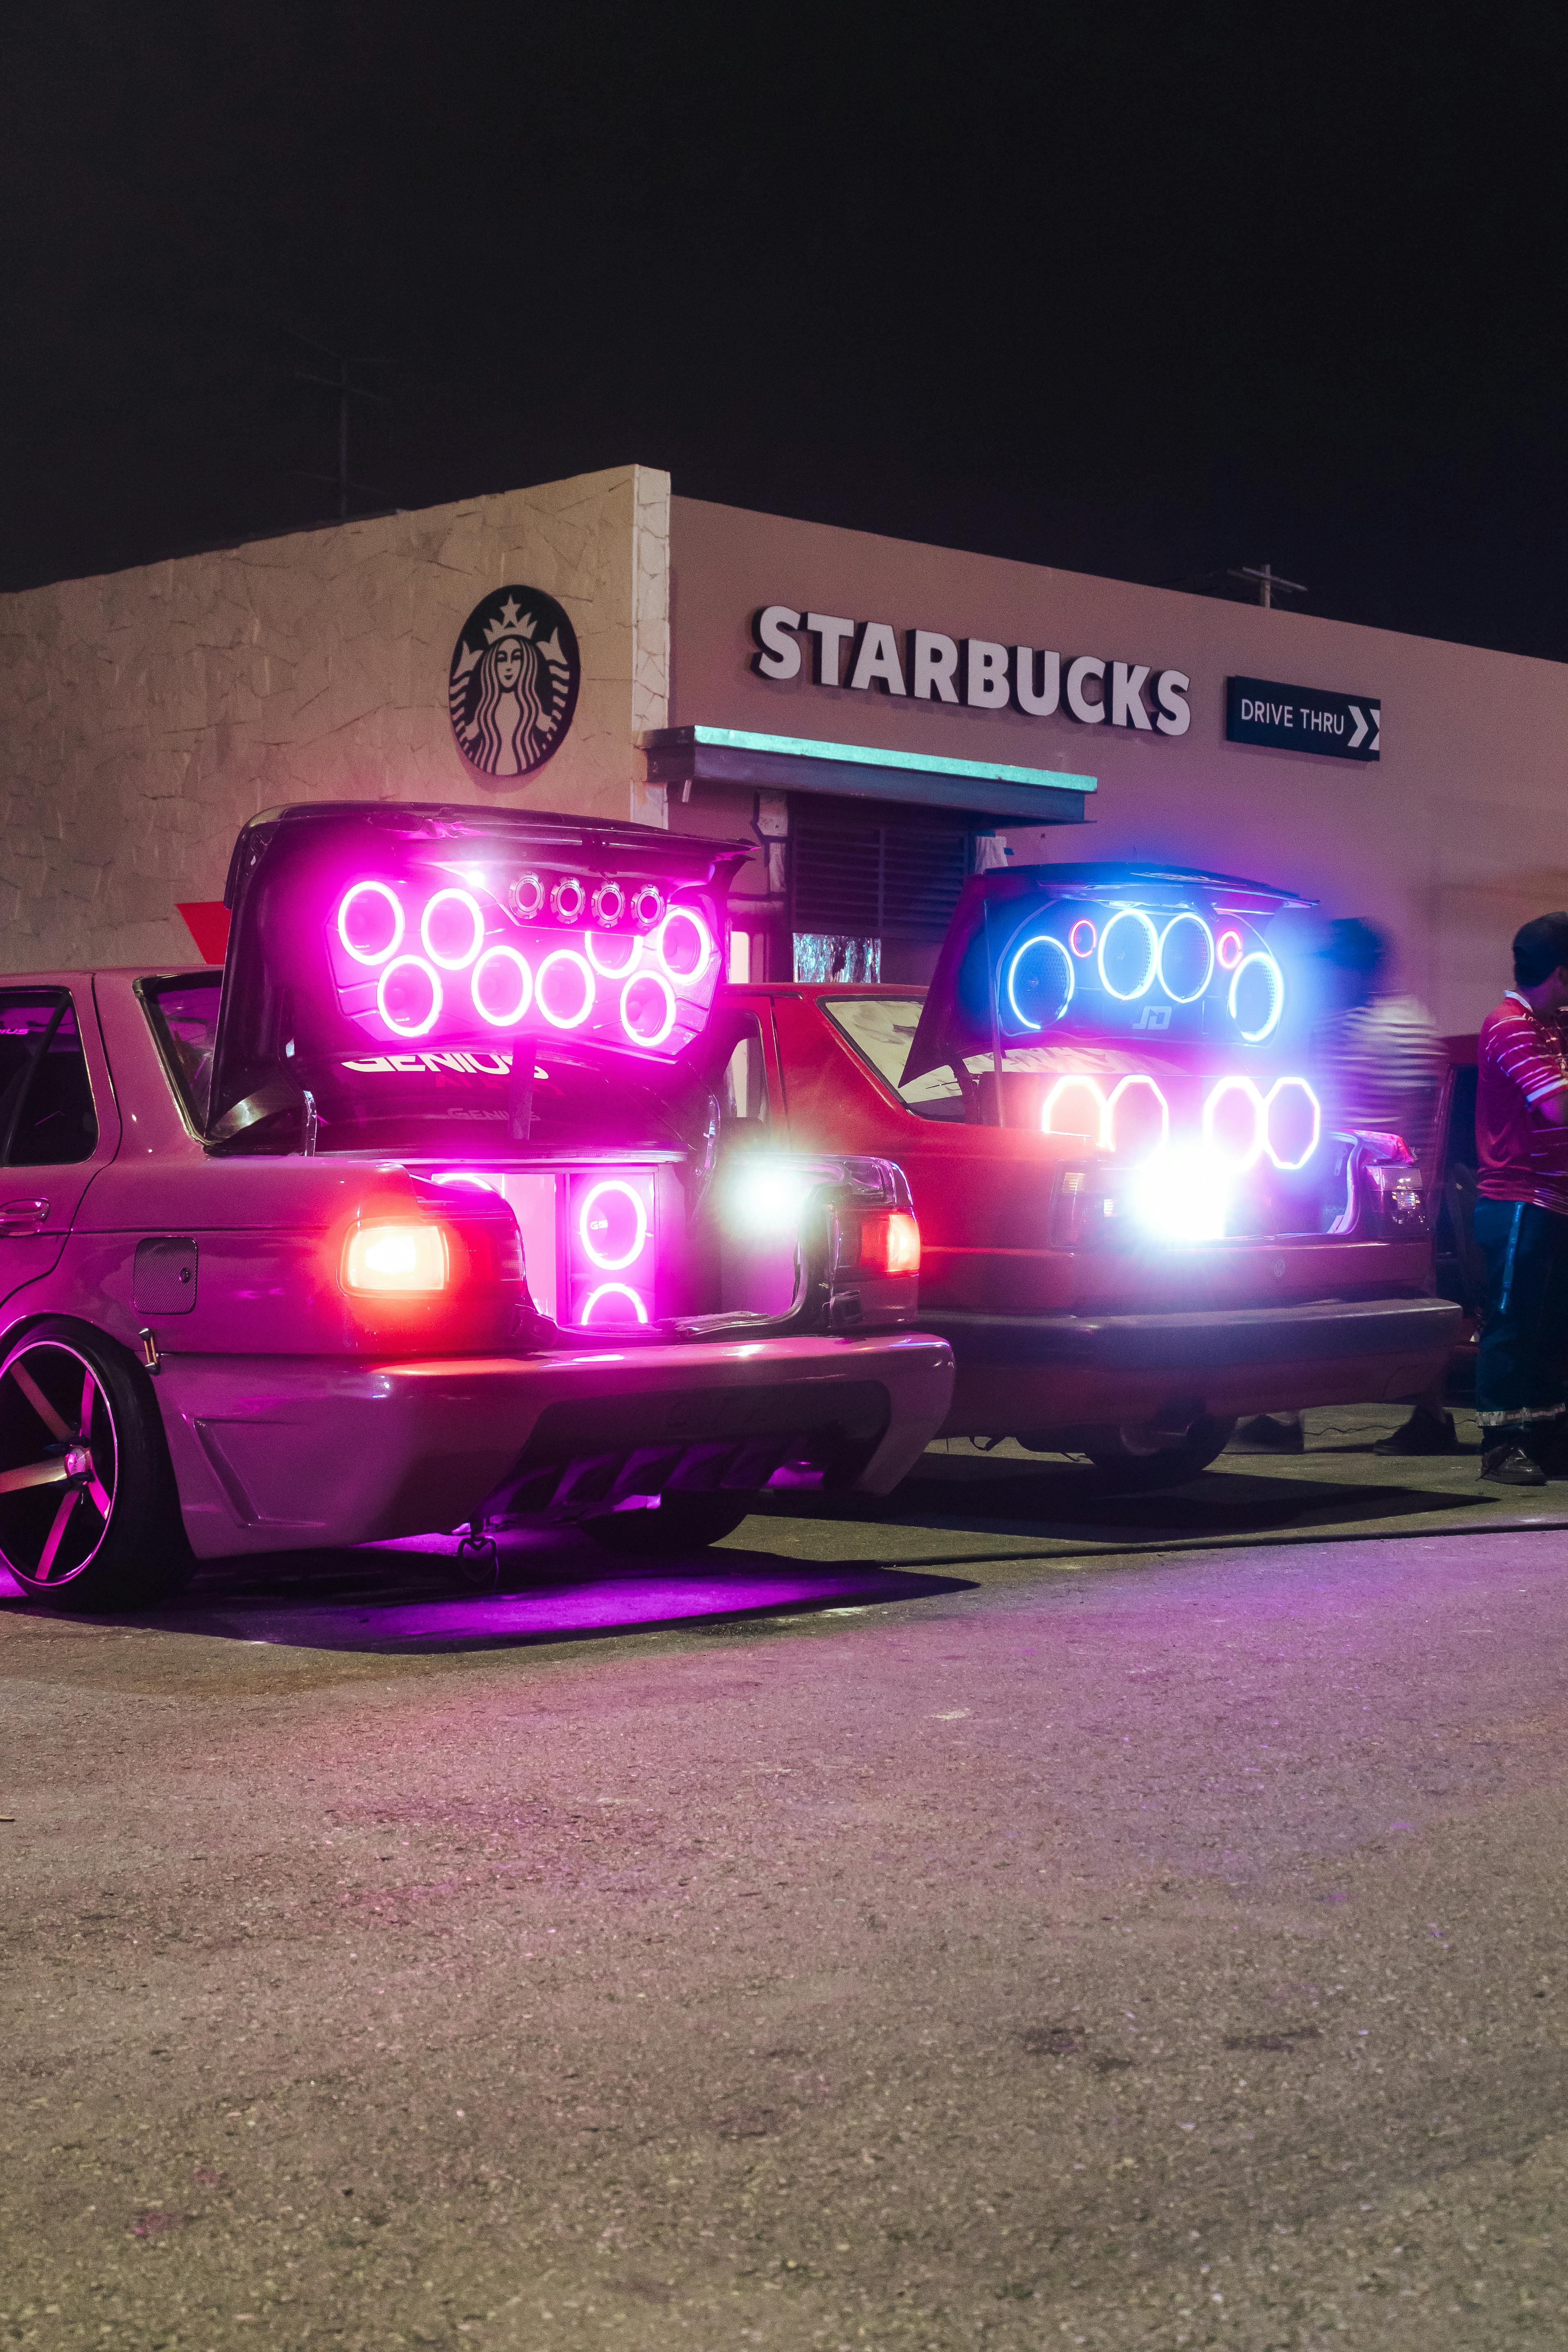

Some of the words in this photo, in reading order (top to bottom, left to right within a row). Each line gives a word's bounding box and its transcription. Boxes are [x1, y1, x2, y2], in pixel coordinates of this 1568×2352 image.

[758, 605, 1191, 735] STARBUCKS
[1241, 698, 1293, 727] DRIVE
[1300, 708, 1344, 735] THRU
